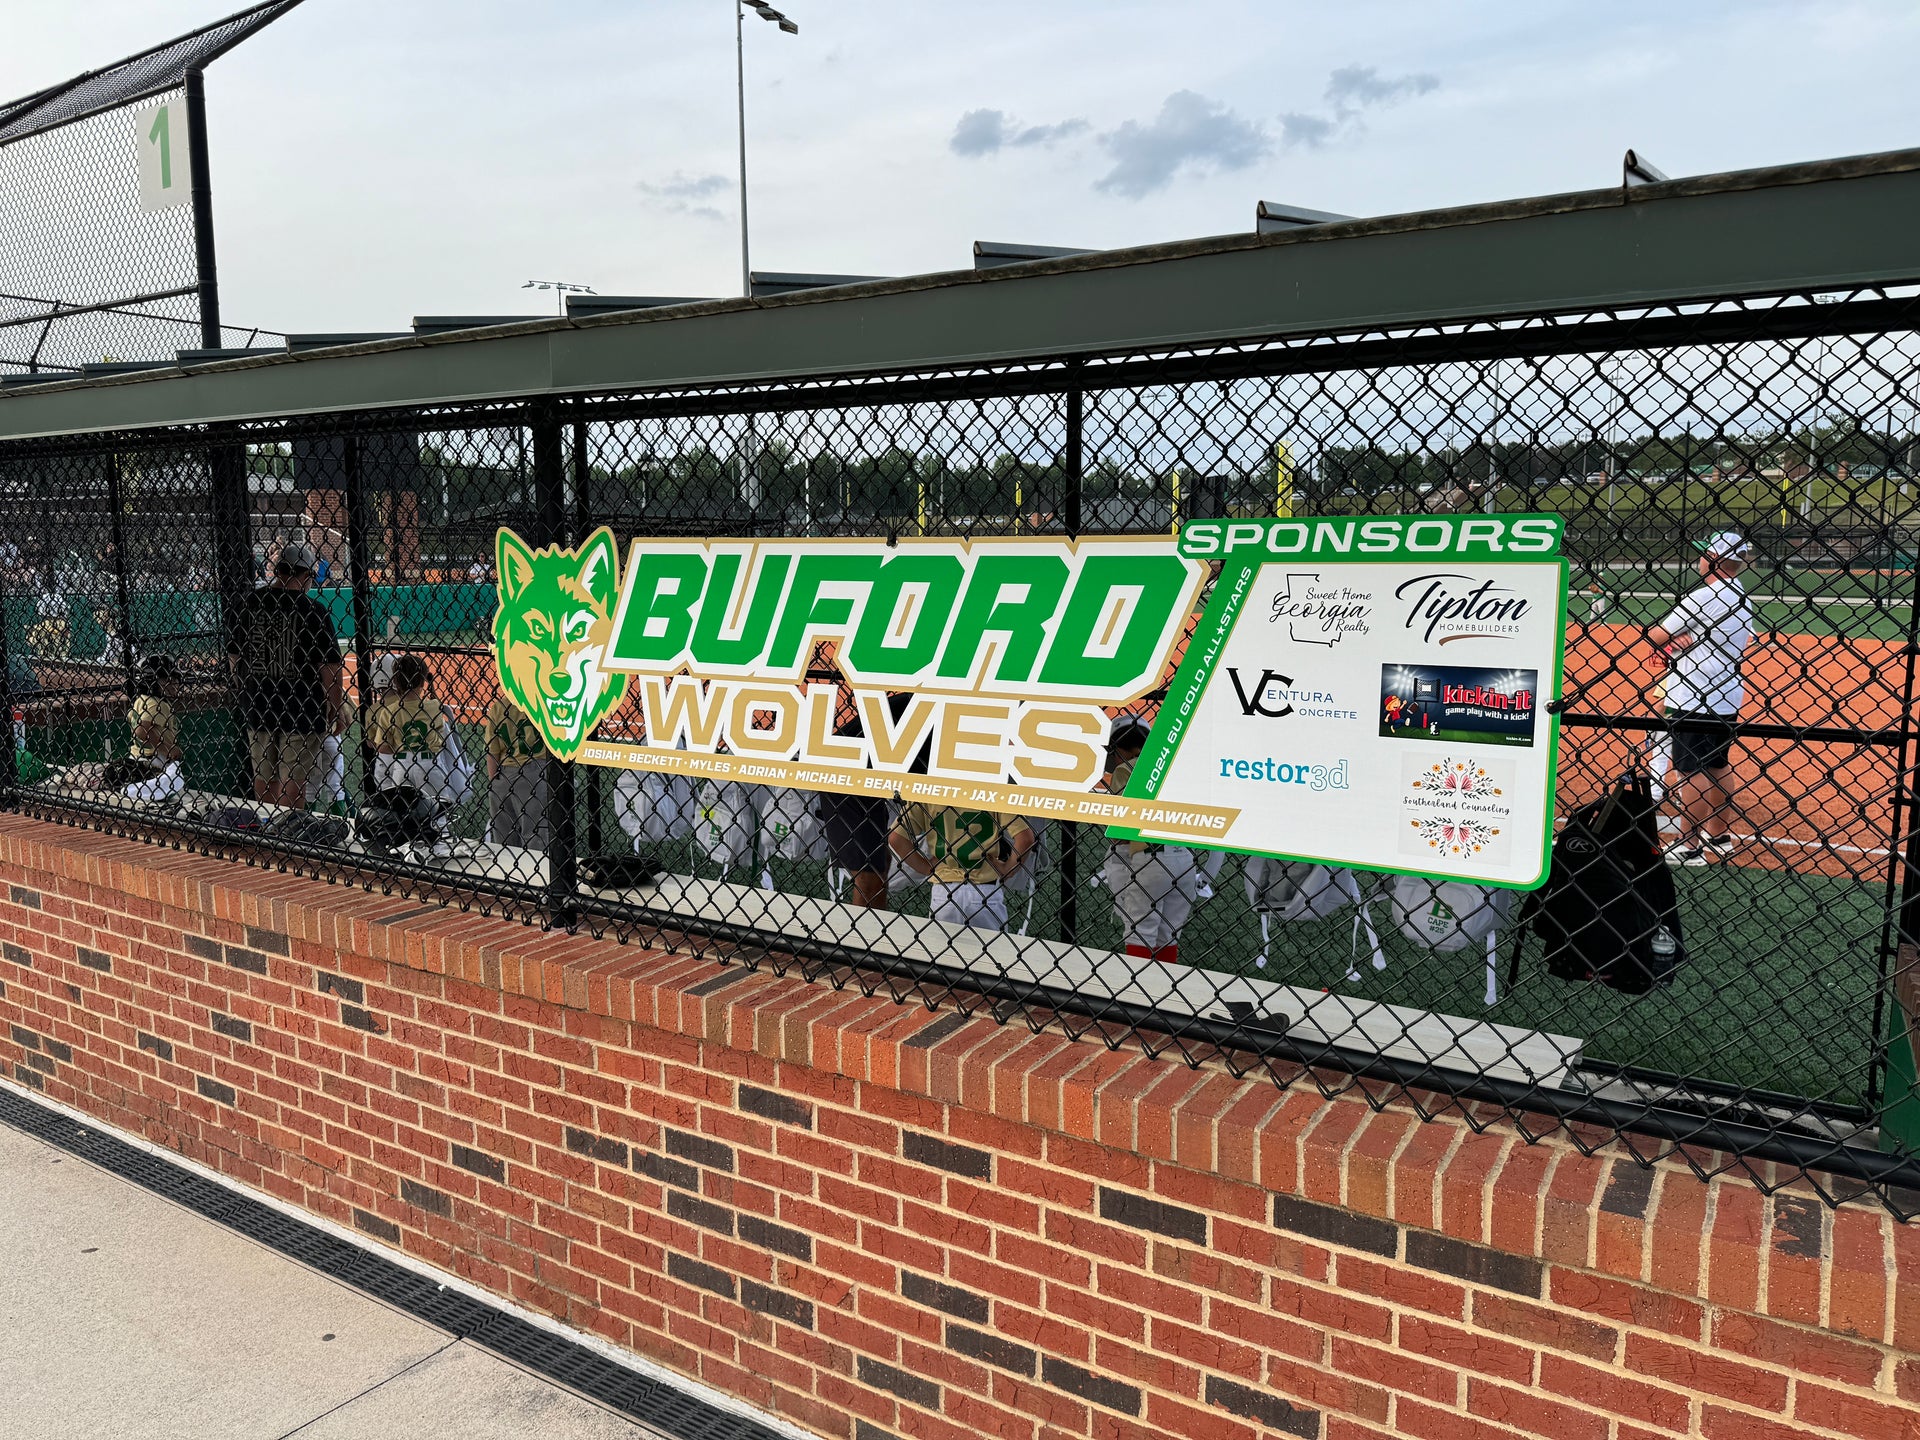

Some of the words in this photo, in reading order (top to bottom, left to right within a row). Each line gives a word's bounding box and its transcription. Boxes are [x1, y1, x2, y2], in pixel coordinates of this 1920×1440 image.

[149, 105, 171, 189] 1
[1183, 519, 1558, 553] SPONSORS
[1305, 586, 1338, 600] Sweet
[1341, 586, 1373, 601] Home
[1394, 573, 1533, 644] Tipton
[612, 553, 1189, 688] BUFORD
[1268, 591, 1373, 632] Georgia
[1335, 619, 1370, 636] Realty
[1439, 623, 1520, 633] HOMEBUILDERS
[1442, 684, 1533, 710] kickin-it
[1445, 706, 1466, 717] game
[1467, 706, 1483, 718] play
[1485, 709, 1503, 720] with
[1503, 713, 1509, 721] a
[1510, 712, 1530, 721] kick!
[644, 680, 1103, 785] WOLVES
[1145, 747, 1170, 793] 2024
[1167, 718, 1183, 744] 6U
[1180, 669, 1206, 716] GOLD
[582, 747, 622, 761] JOSIAH
[628, 752, 683, 768] BECKETT
[688, 758, 731, 773] MYLES
[738, 764, 787, 780] ADRIAN
[795, 770, 854, 787] MICHAEL
[863, 777, 903, 792] BEAU
[911, 782, 962, 799] RHETT
[969, 788, 998, 803] JAX
[1007, 793, 1067, 811] OLIVER
[1077, 801, 1130, 818] DREW
[1139, 807, 1227, 829] HAWKINS
[1219, 757, 1350, 792] restor3d
[1402, 796, 1458, 810] Southerland
[1461, 802, 1510, 815] Counseling
[773, 821, 789, 837] B
[930, 810, 994, 870] 12
